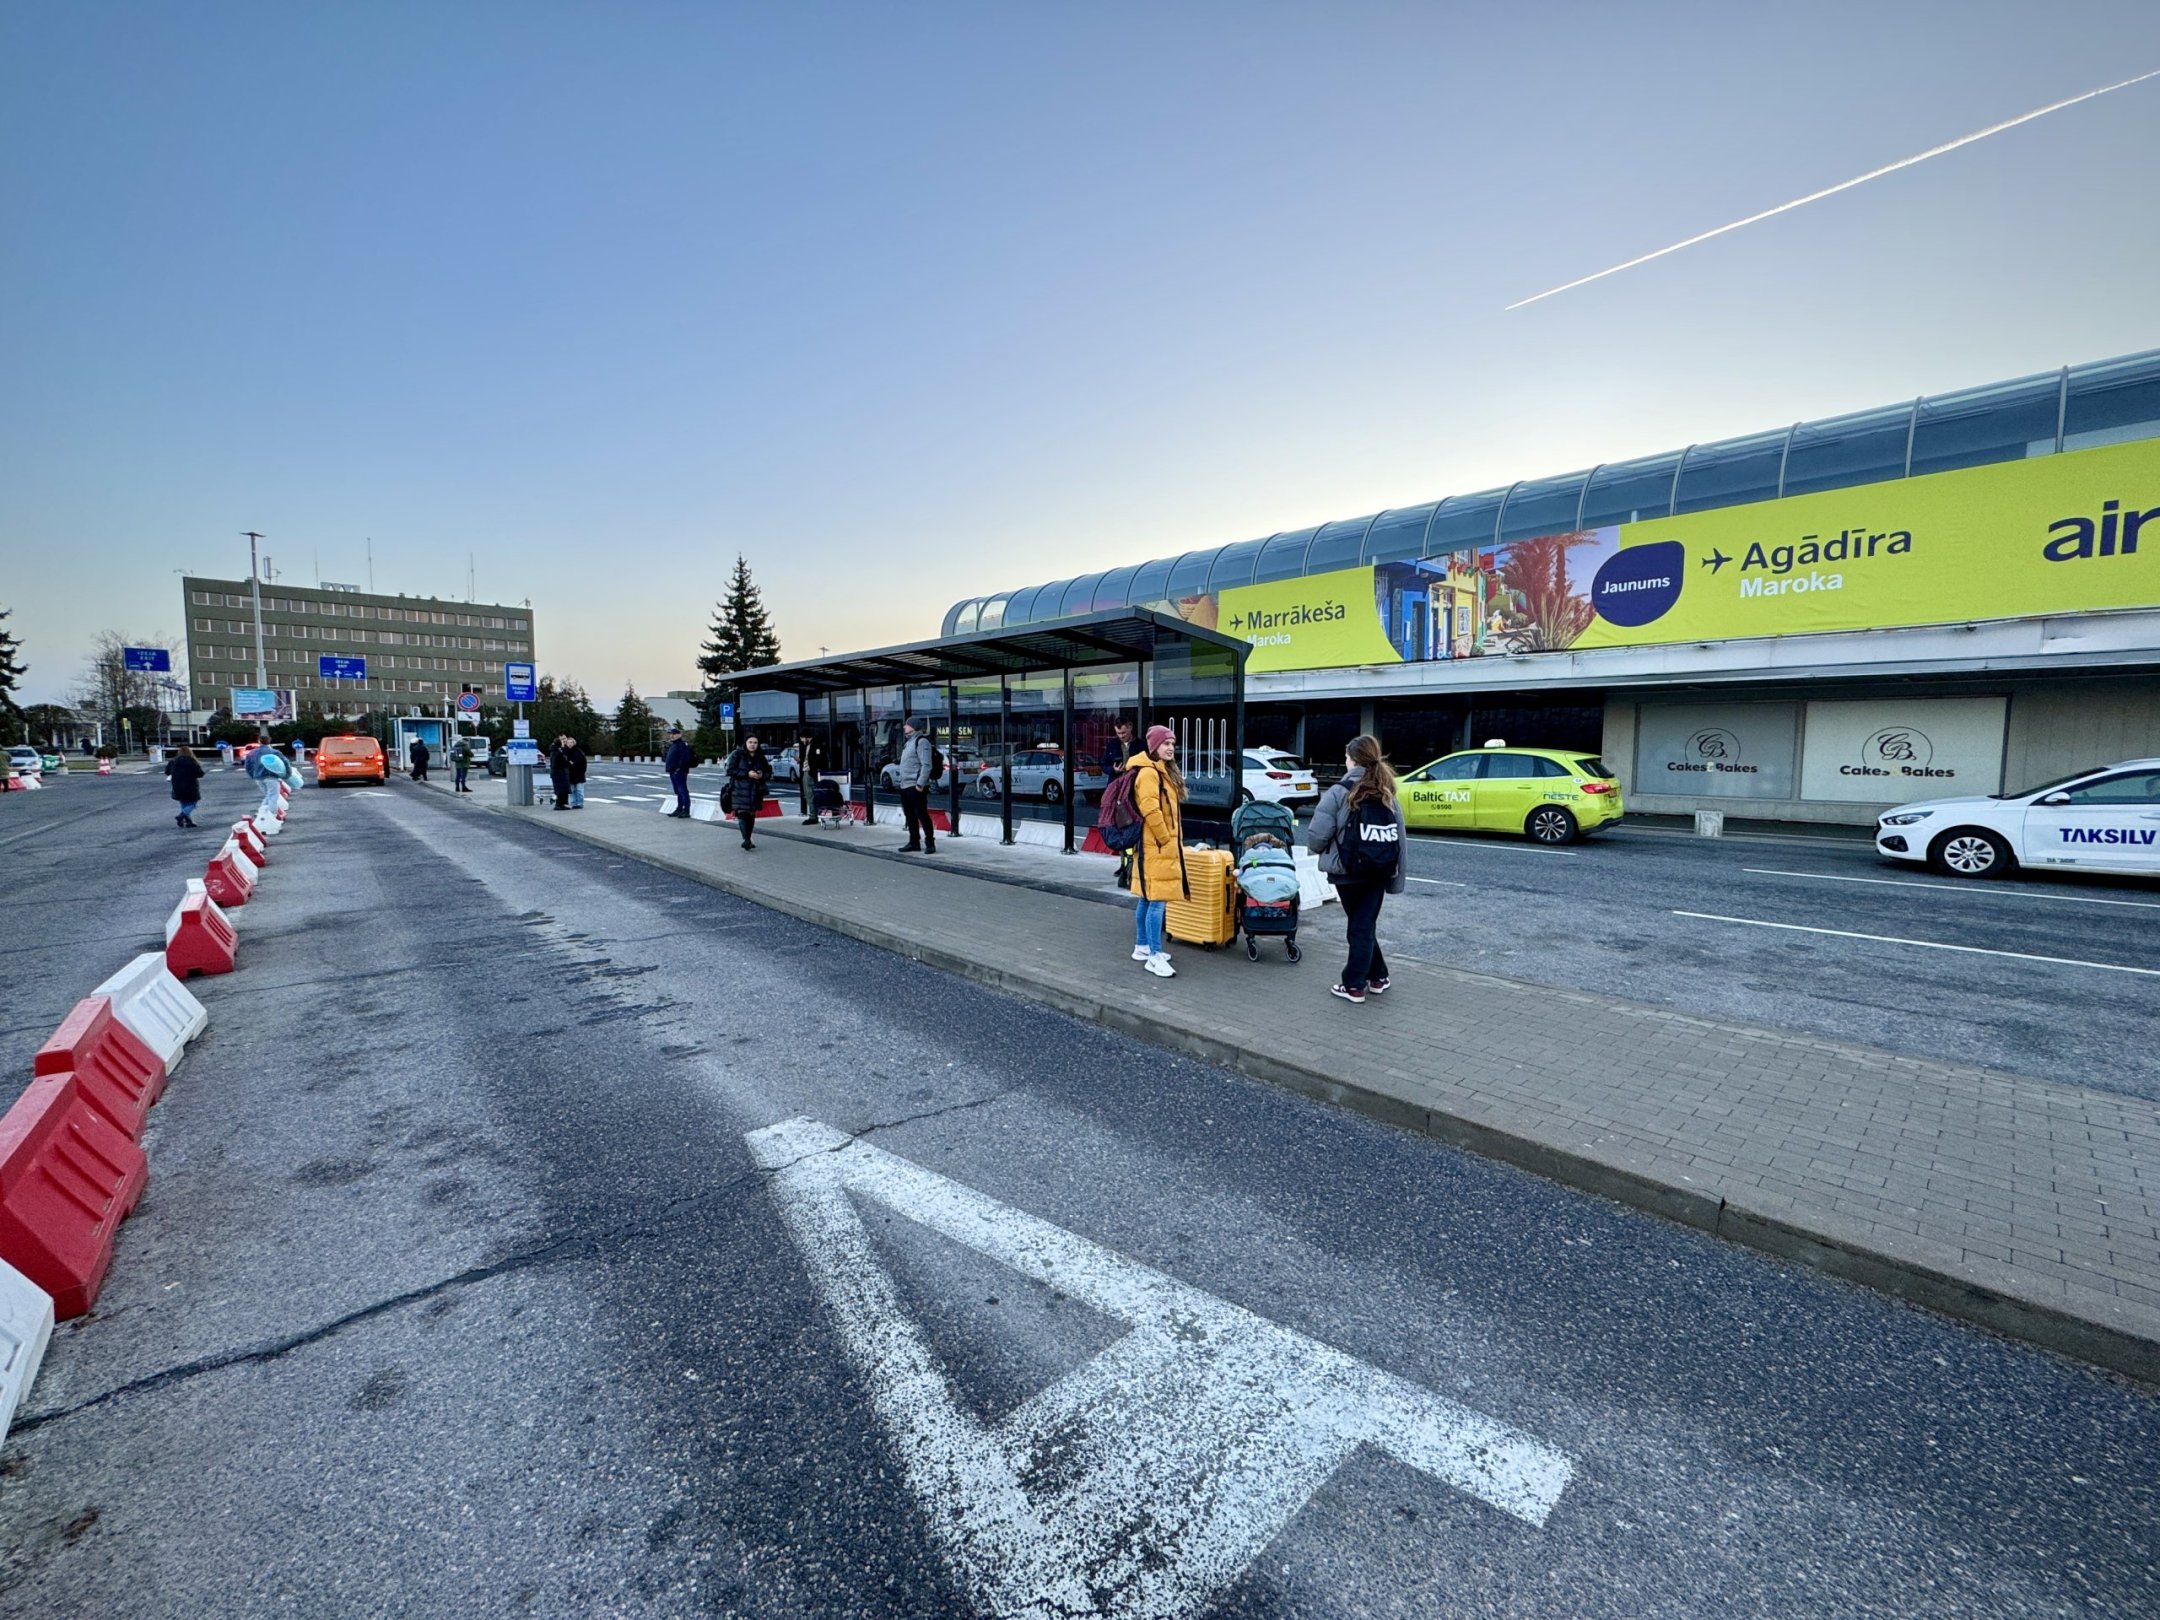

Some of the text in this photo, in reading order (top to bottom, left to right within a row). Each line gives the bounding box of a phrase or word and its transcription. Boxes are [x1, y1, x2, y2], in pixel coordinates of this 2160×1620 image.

[1740, 528, 1912, 574] Agādīra
[1601, 574, 1671, 595] Jaunums
[1739, 571, 1843, 599] Maroka
[1247, 599, 1345, 630] Marrākeša
[936, 726, 973, 736] NARSEN
[1667, 762, 1708, 772] Cakes
[1715, 763, 1758, 773] Bakes
[1839, 765, 1891, 776] Cakes
[1901, 766, 1955, 777] Bakes
[1360, 822, 1399, 842] VANS
